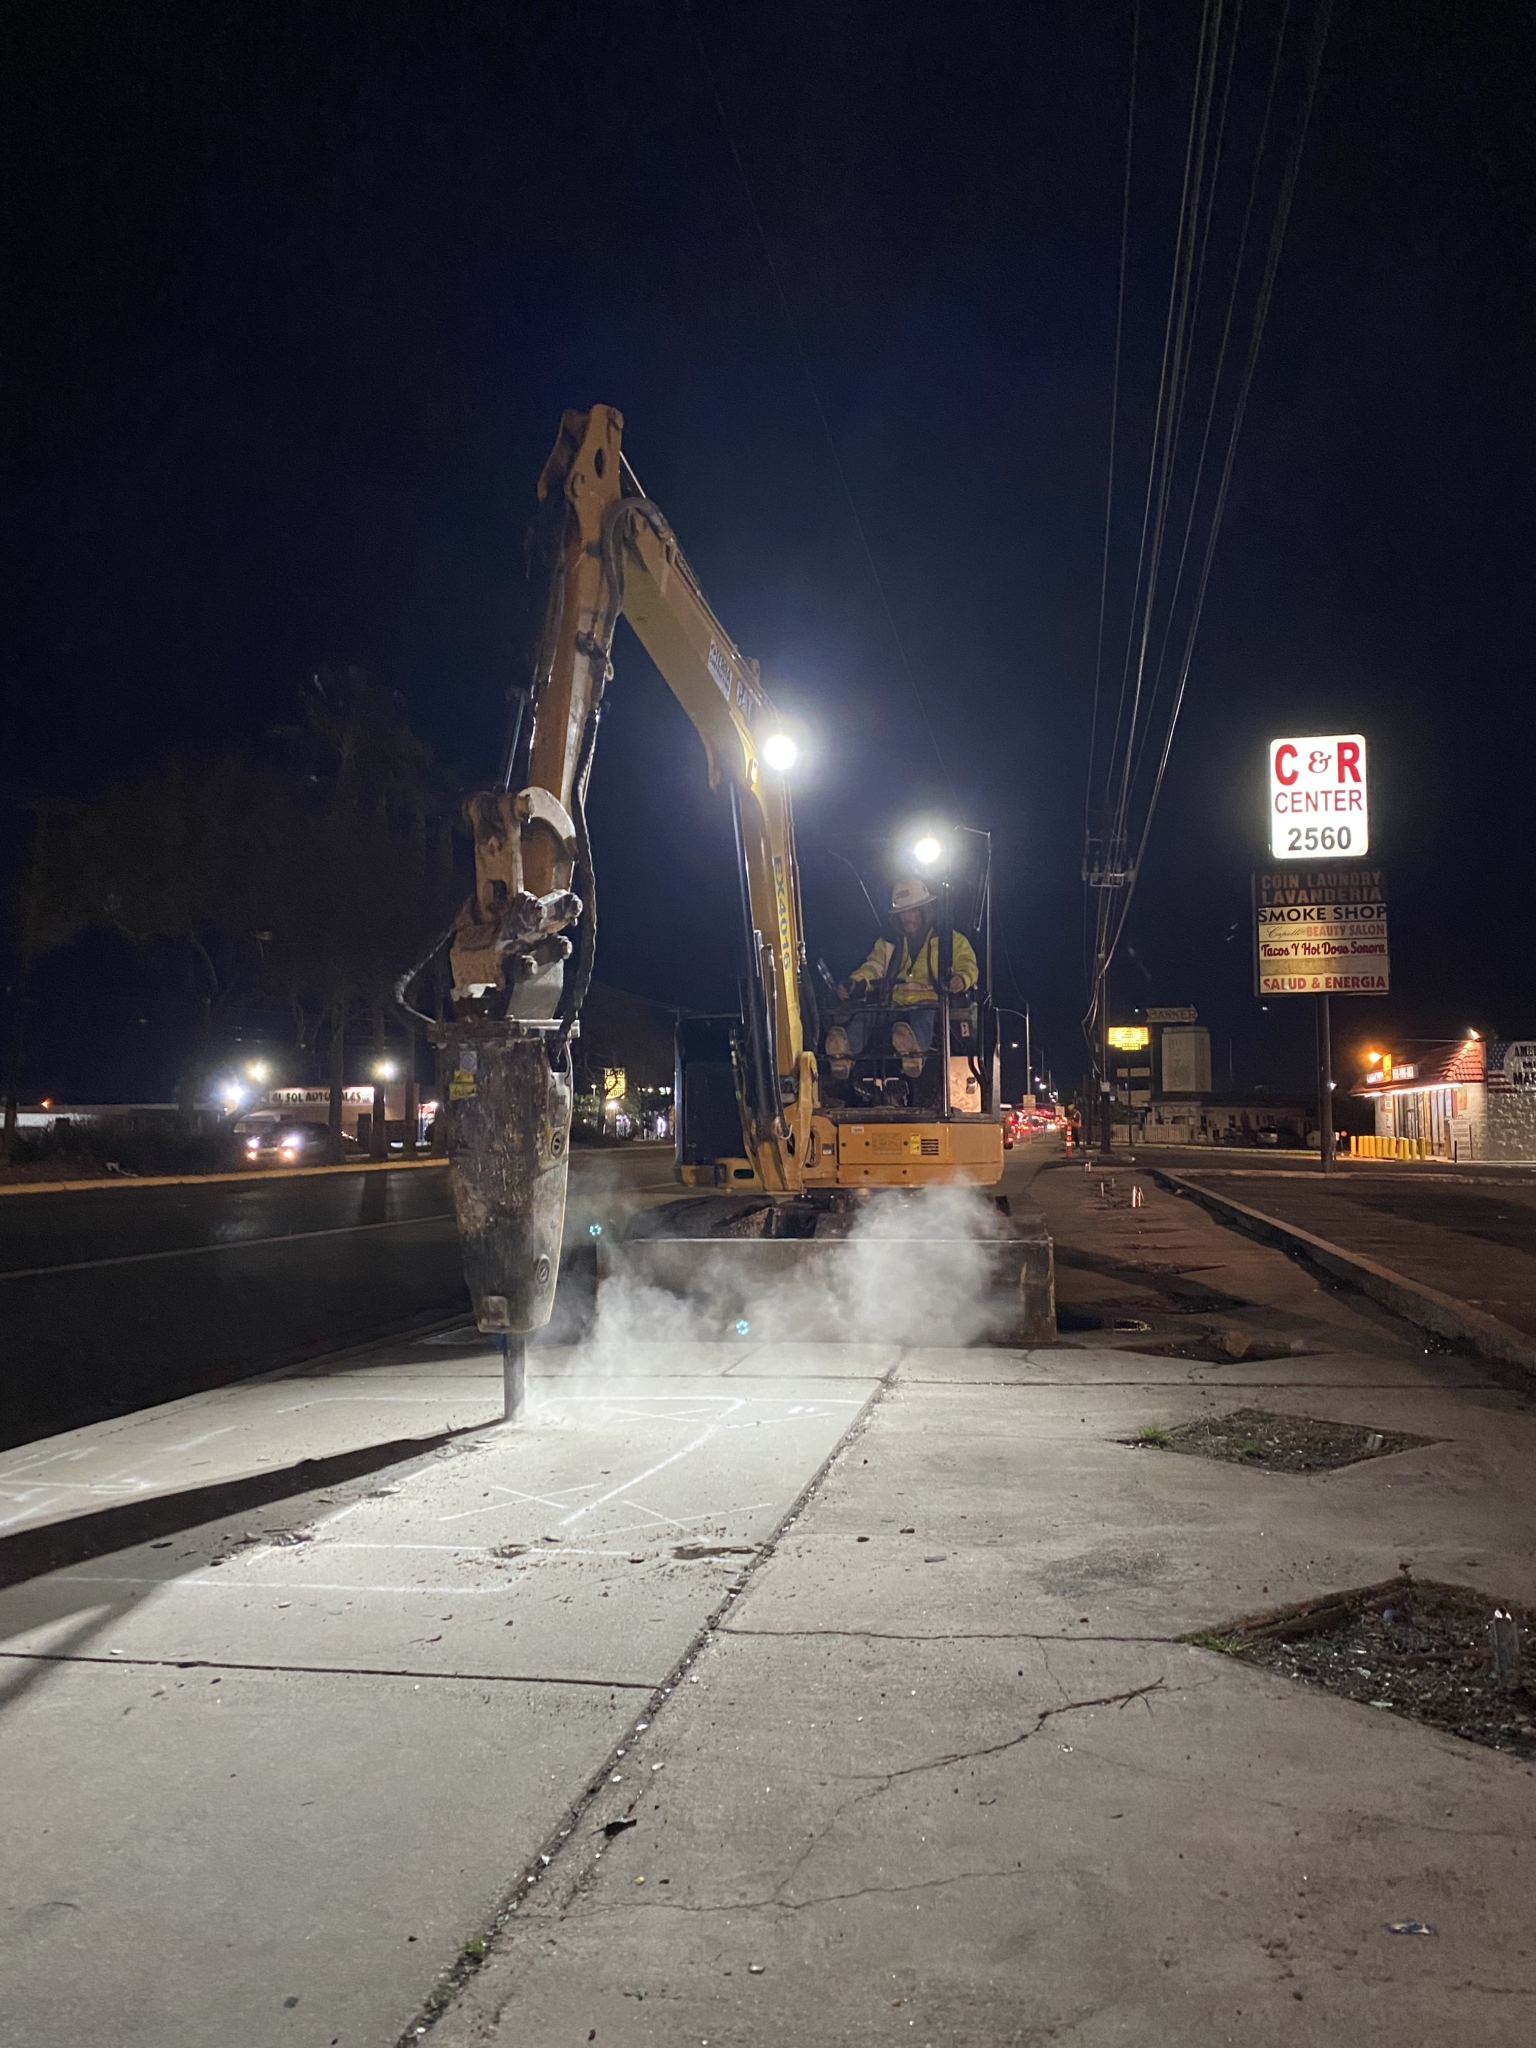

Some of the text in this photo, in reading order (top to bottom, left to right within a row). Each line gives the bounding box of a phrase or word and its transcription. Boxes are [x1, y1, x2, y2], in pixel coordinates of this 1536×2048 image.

[1275, 742, 1362, 786] C & R
[1274, 789, 1363, 813] CENTER
[1287, 826, 1352, 851] 2560
[1261, 871, 1381, 890] COIN LAUNDRY
[1261, 887, 1382, 905] LAVANDERIA
[773, 856, 792, 970] EX4016
[1258, 905, 1387, 922] SMOKE SHOP
[1306, 925, 1346, 937] BEAUTY
[1349, 924, 1385, 936] SALON
[1261, 941, 1386, 957] Tacos Y Hot Dogs Sonora
[1263, 976, 1387, 990] SALUD & ENERGIA
[1149, 1009, 1196, 1020] BARKER
[286, 1092, 303, 1102] SOL
